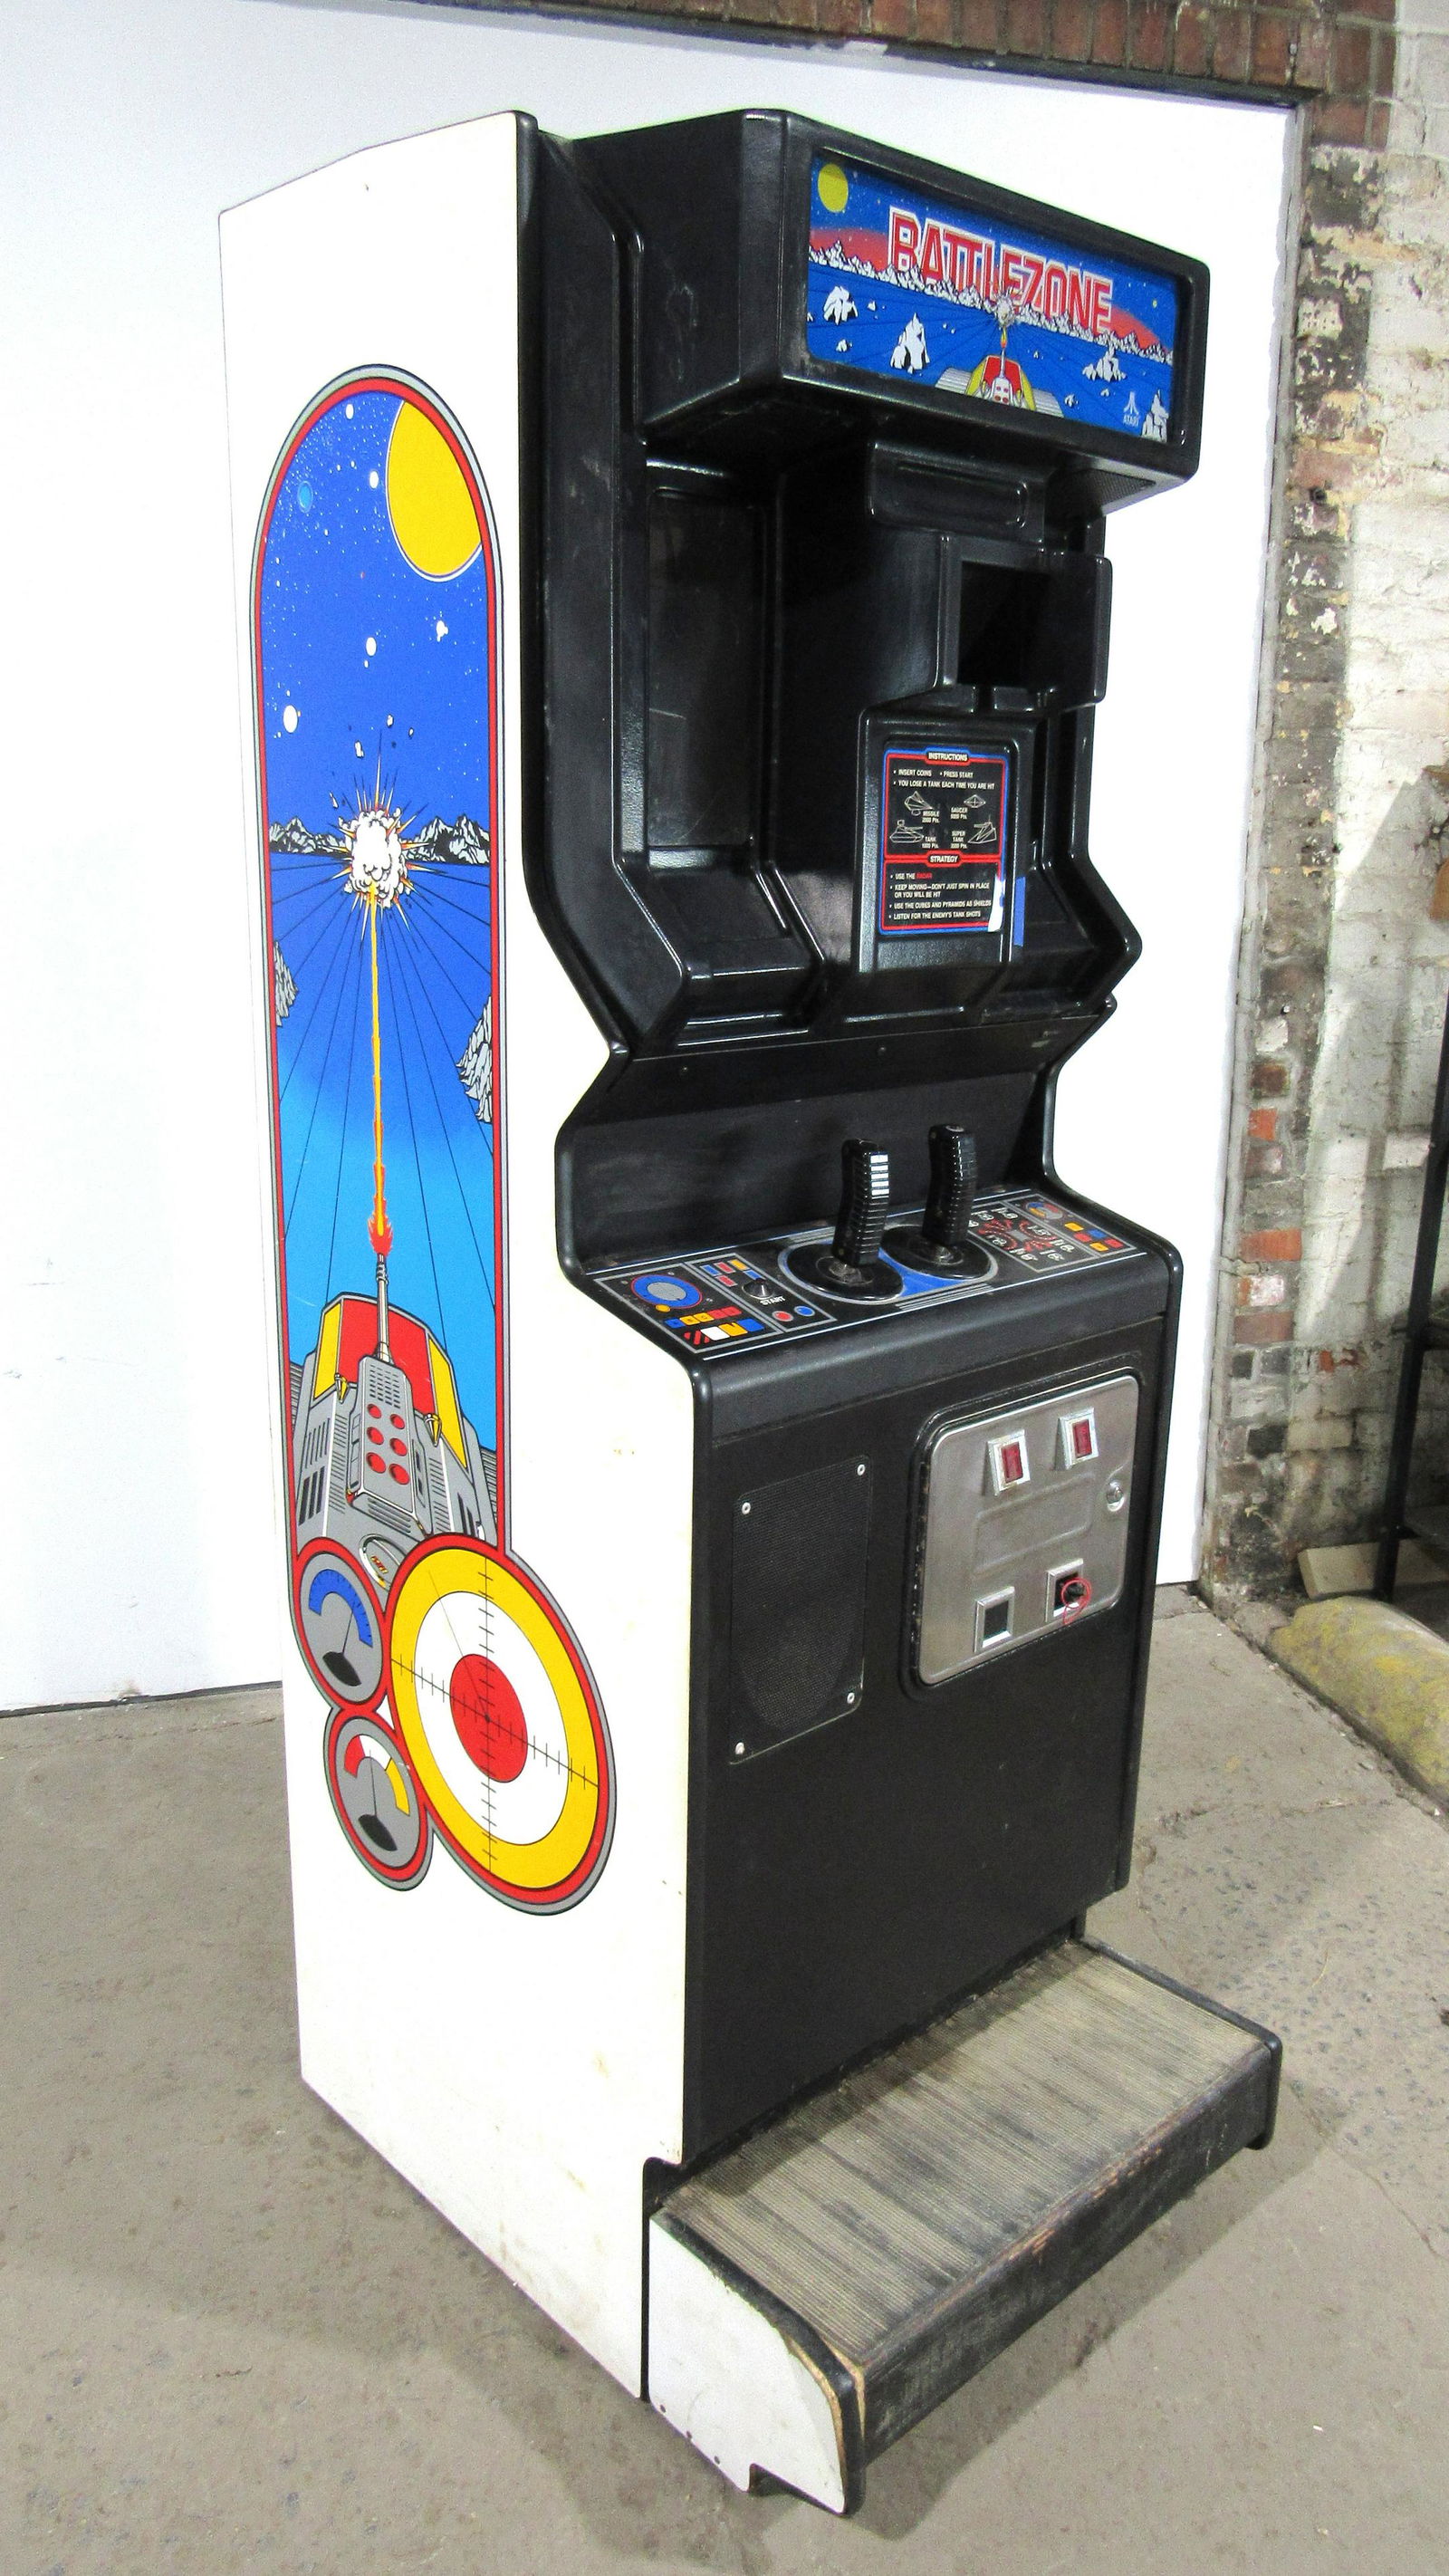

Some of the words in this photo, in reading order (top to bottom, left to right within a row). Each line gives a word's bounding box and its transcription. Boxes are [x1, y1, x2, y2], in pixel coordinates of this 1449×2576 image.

[887, 206, 1112, 333] BATTLEZONE
[1123, 413, 1139, 427] ATARI
[928, 752, 968, 761] INSTRUCTIONS
[916, 871, 932, 879] RADAR
[759, 1295, 786, 1305] START
